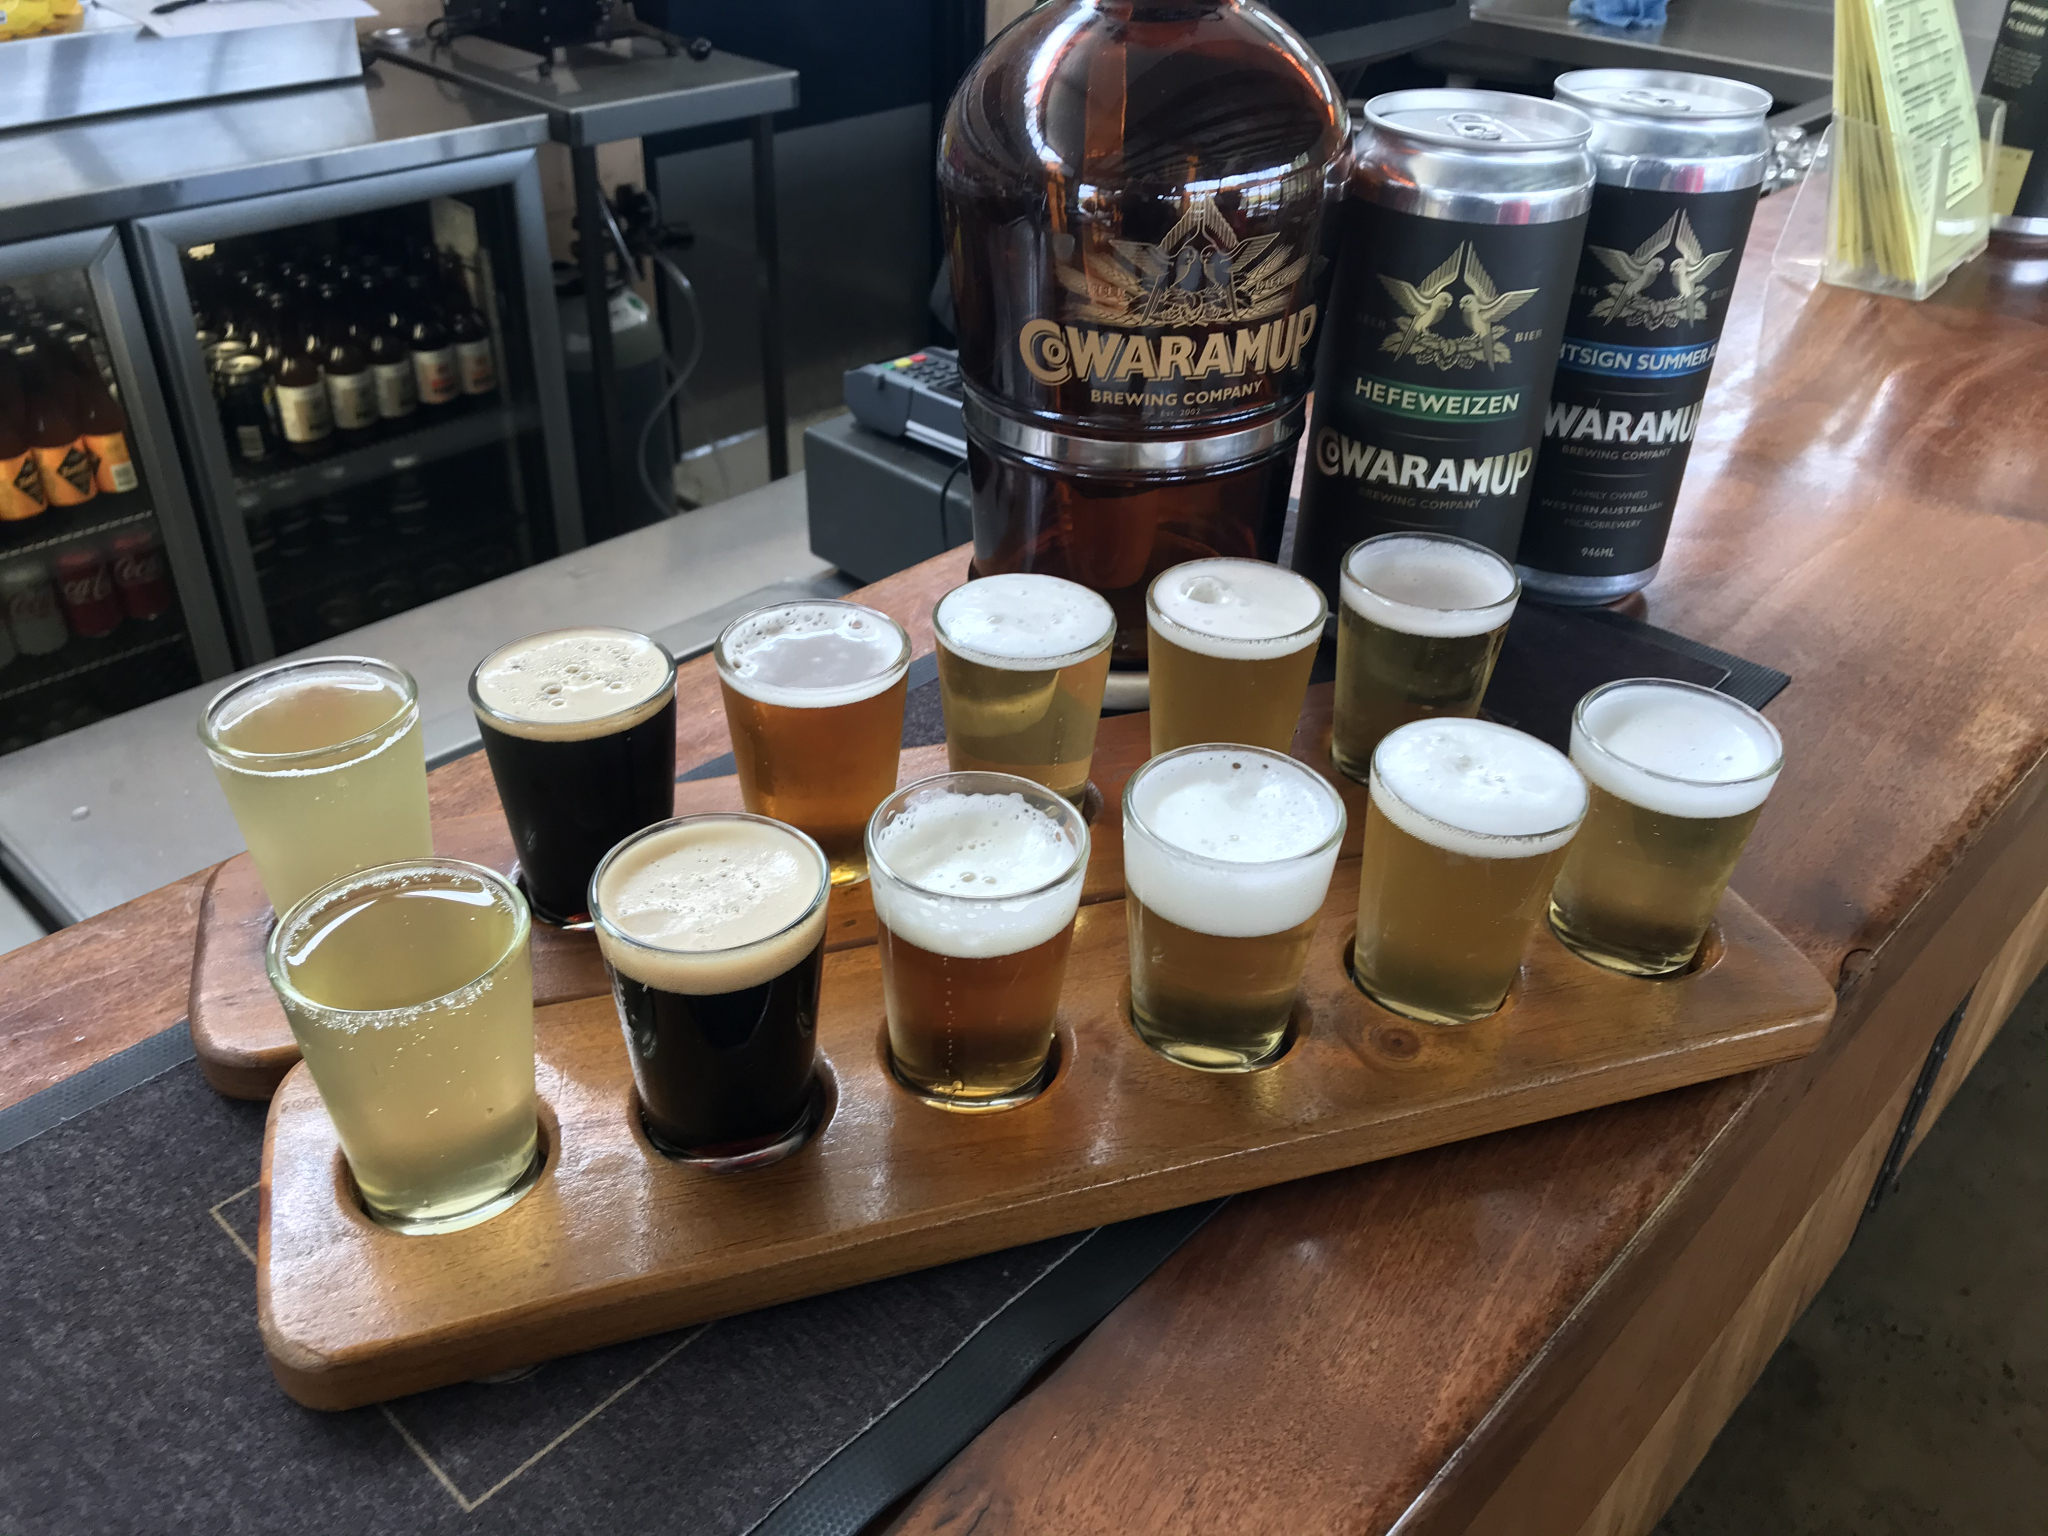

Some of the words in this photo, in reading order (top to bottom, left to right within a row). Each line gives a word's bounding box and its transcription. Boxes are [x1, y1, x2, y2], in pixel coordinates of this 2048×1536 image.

[1514, 329, 1543, 343] BIER
[1560, 342, 1634, 370] TSIGN
[1636, 348, 1710, 371] SUMMER
[1090, 388, 1178, 406] BREWING
[1183, 380, 1263, 406] COMPANY
[1355, 377, 1520, 416] HEFEWEIZEN
[1544, 399, 1704, 443] WARAMU
[1561, 444, 1619, 461] BREWING
[1622, 447, 1673, 461] COMPANY
[1359, 486, 1416, 508] BREWING
[1419, 498, 1482, 511] COMPANY
[1571, 489, 1607, 500] FAMILY
[1609, 490, 1649, 500] OWNED
[1542, 499, 1599, 514] WESTERN
[1600, 501, 1664, 515] AUSTRALIAN
[1564, 518, 1642, 529] MICROBREWERY
[1581, 546, 1615, 558] 946ML
